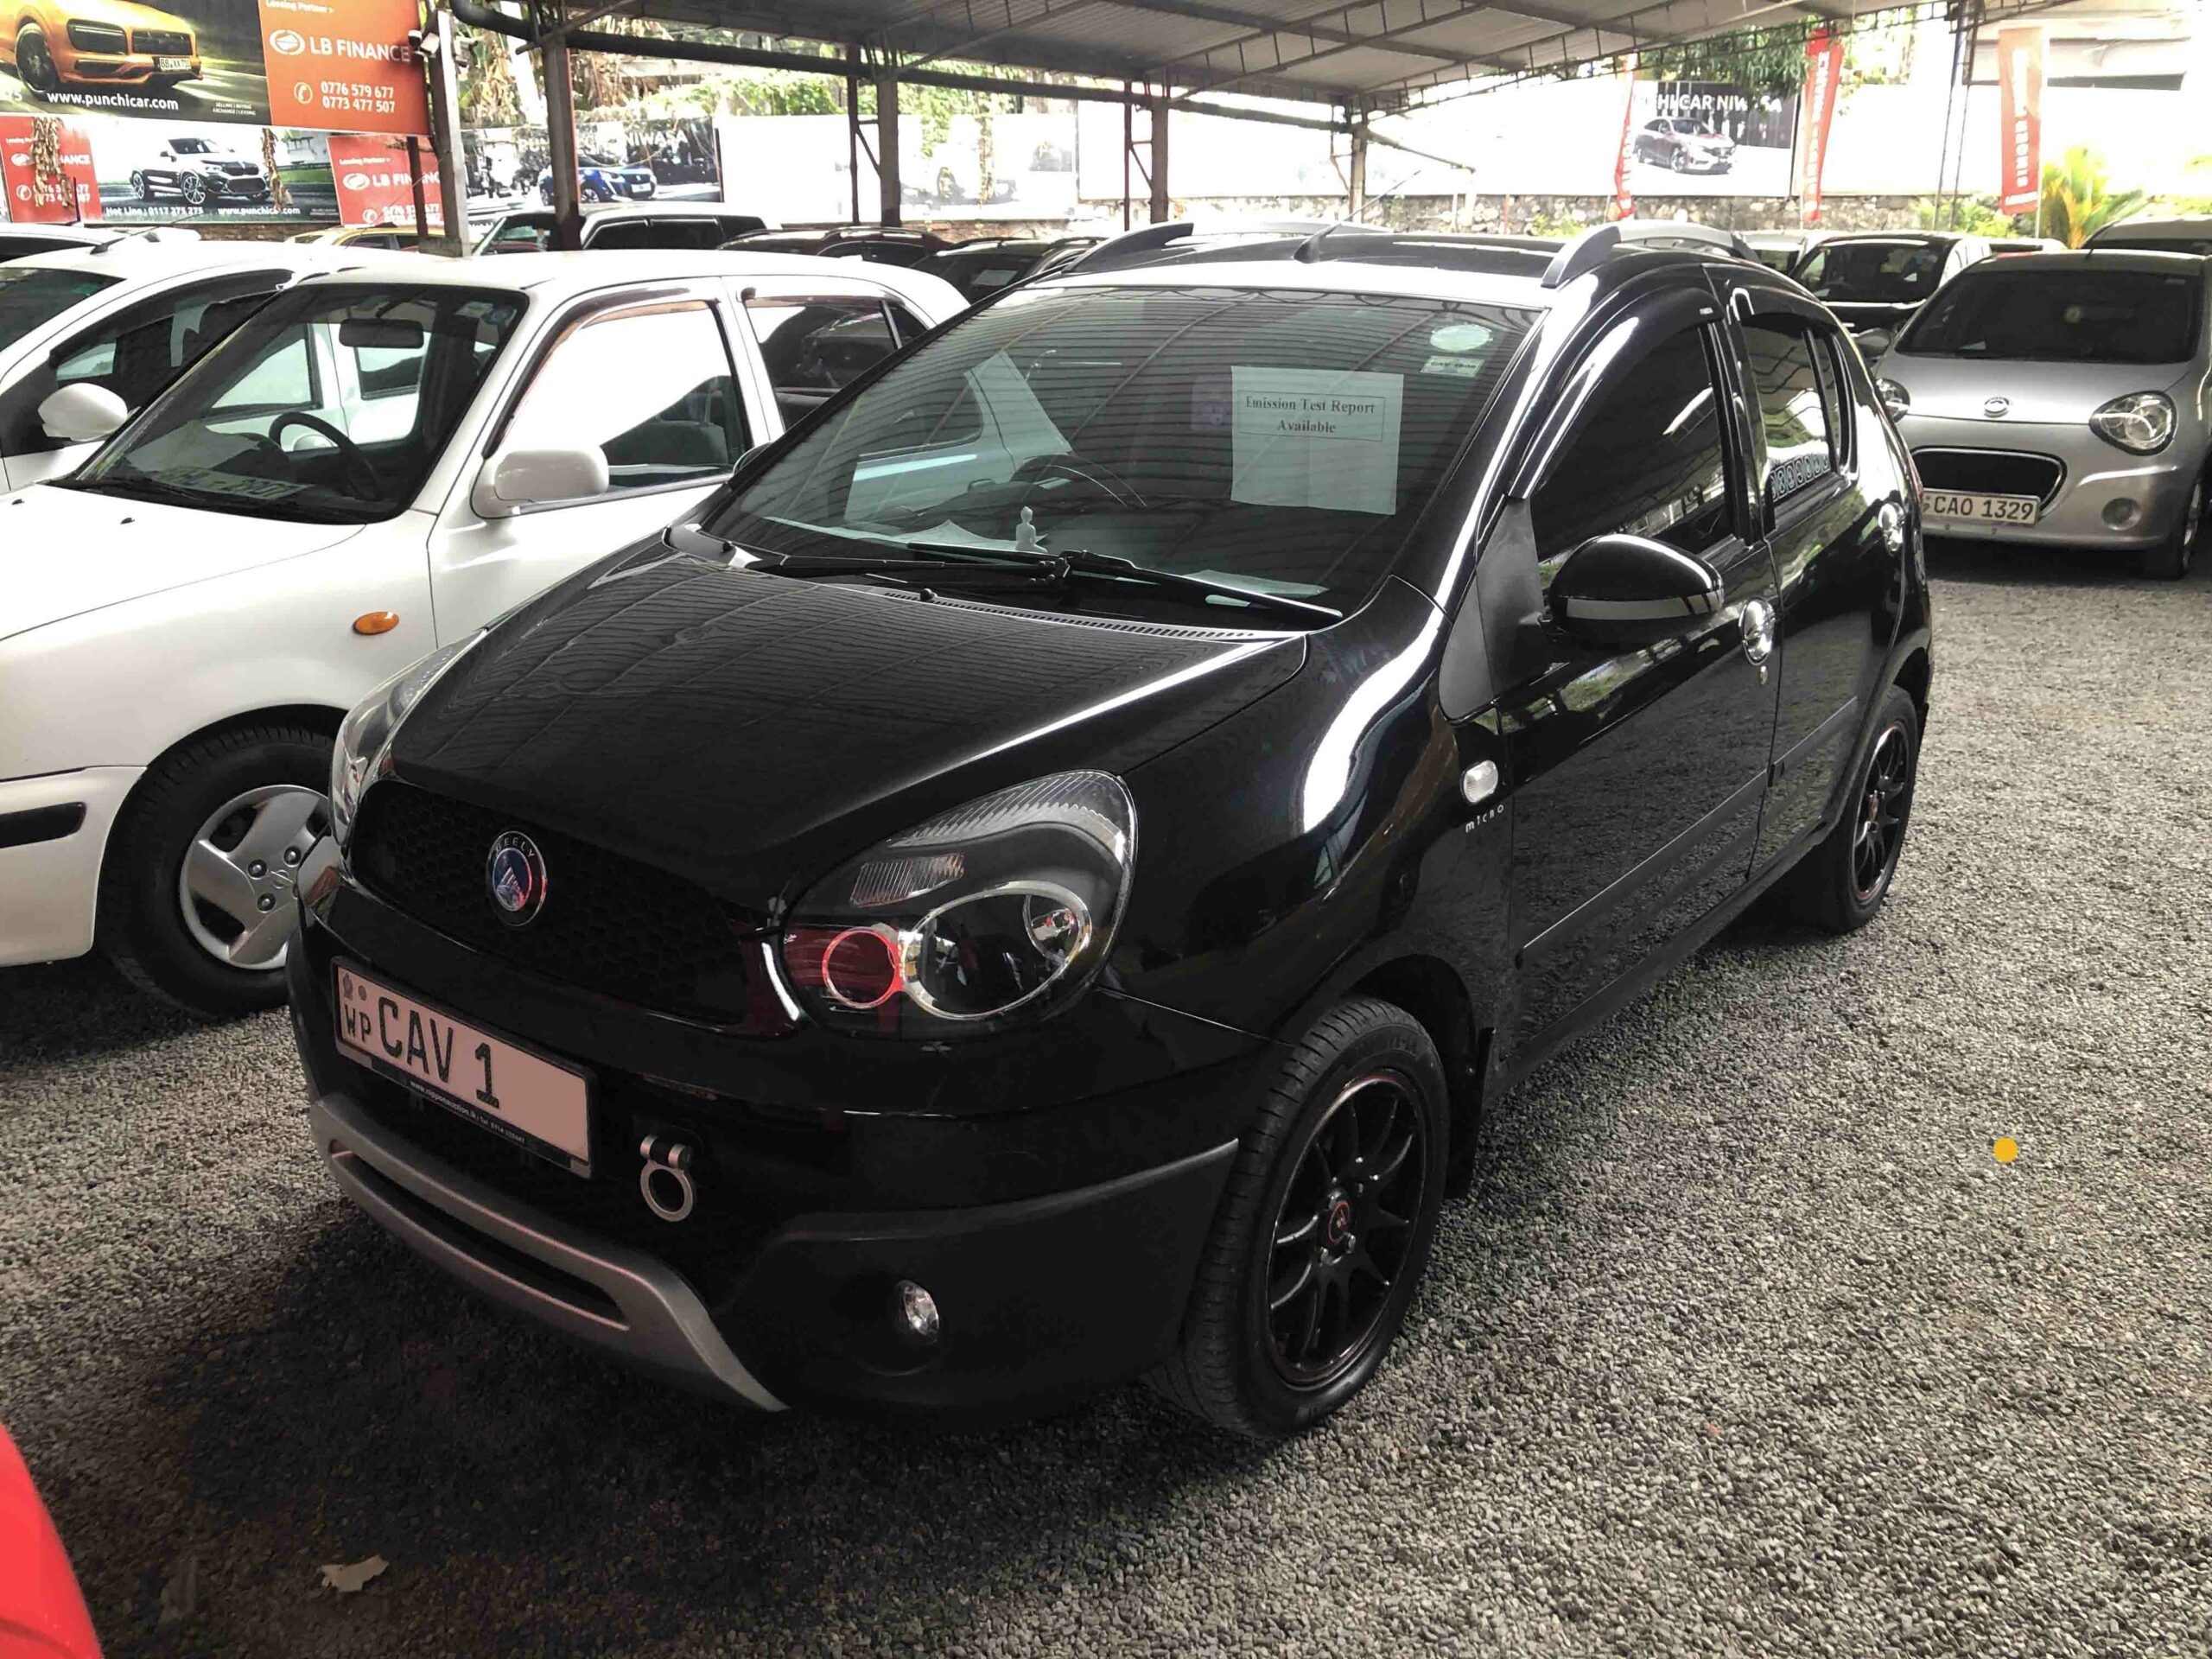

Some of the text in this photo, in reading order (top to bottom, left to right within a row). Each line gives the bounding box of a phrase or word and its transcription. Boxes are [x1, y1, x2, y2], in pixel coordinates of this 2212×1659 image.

[309, 36, 410, 62] LB FINANCE
[321, 81, 394, 99] 0776 579 677
[47, 91, 179, 111] www.punchicar.com
[322, 97, 395, 112] 0773 477 507
[1246, 395, 1376, 415] Emission Test Report
[1277, 420, 1337, 434] Available
[1934, 496, 2034, 520] CAO 1329
[344, 1004, 372, 1042] WP
[378, 996, 499, 1109] CAV 1
